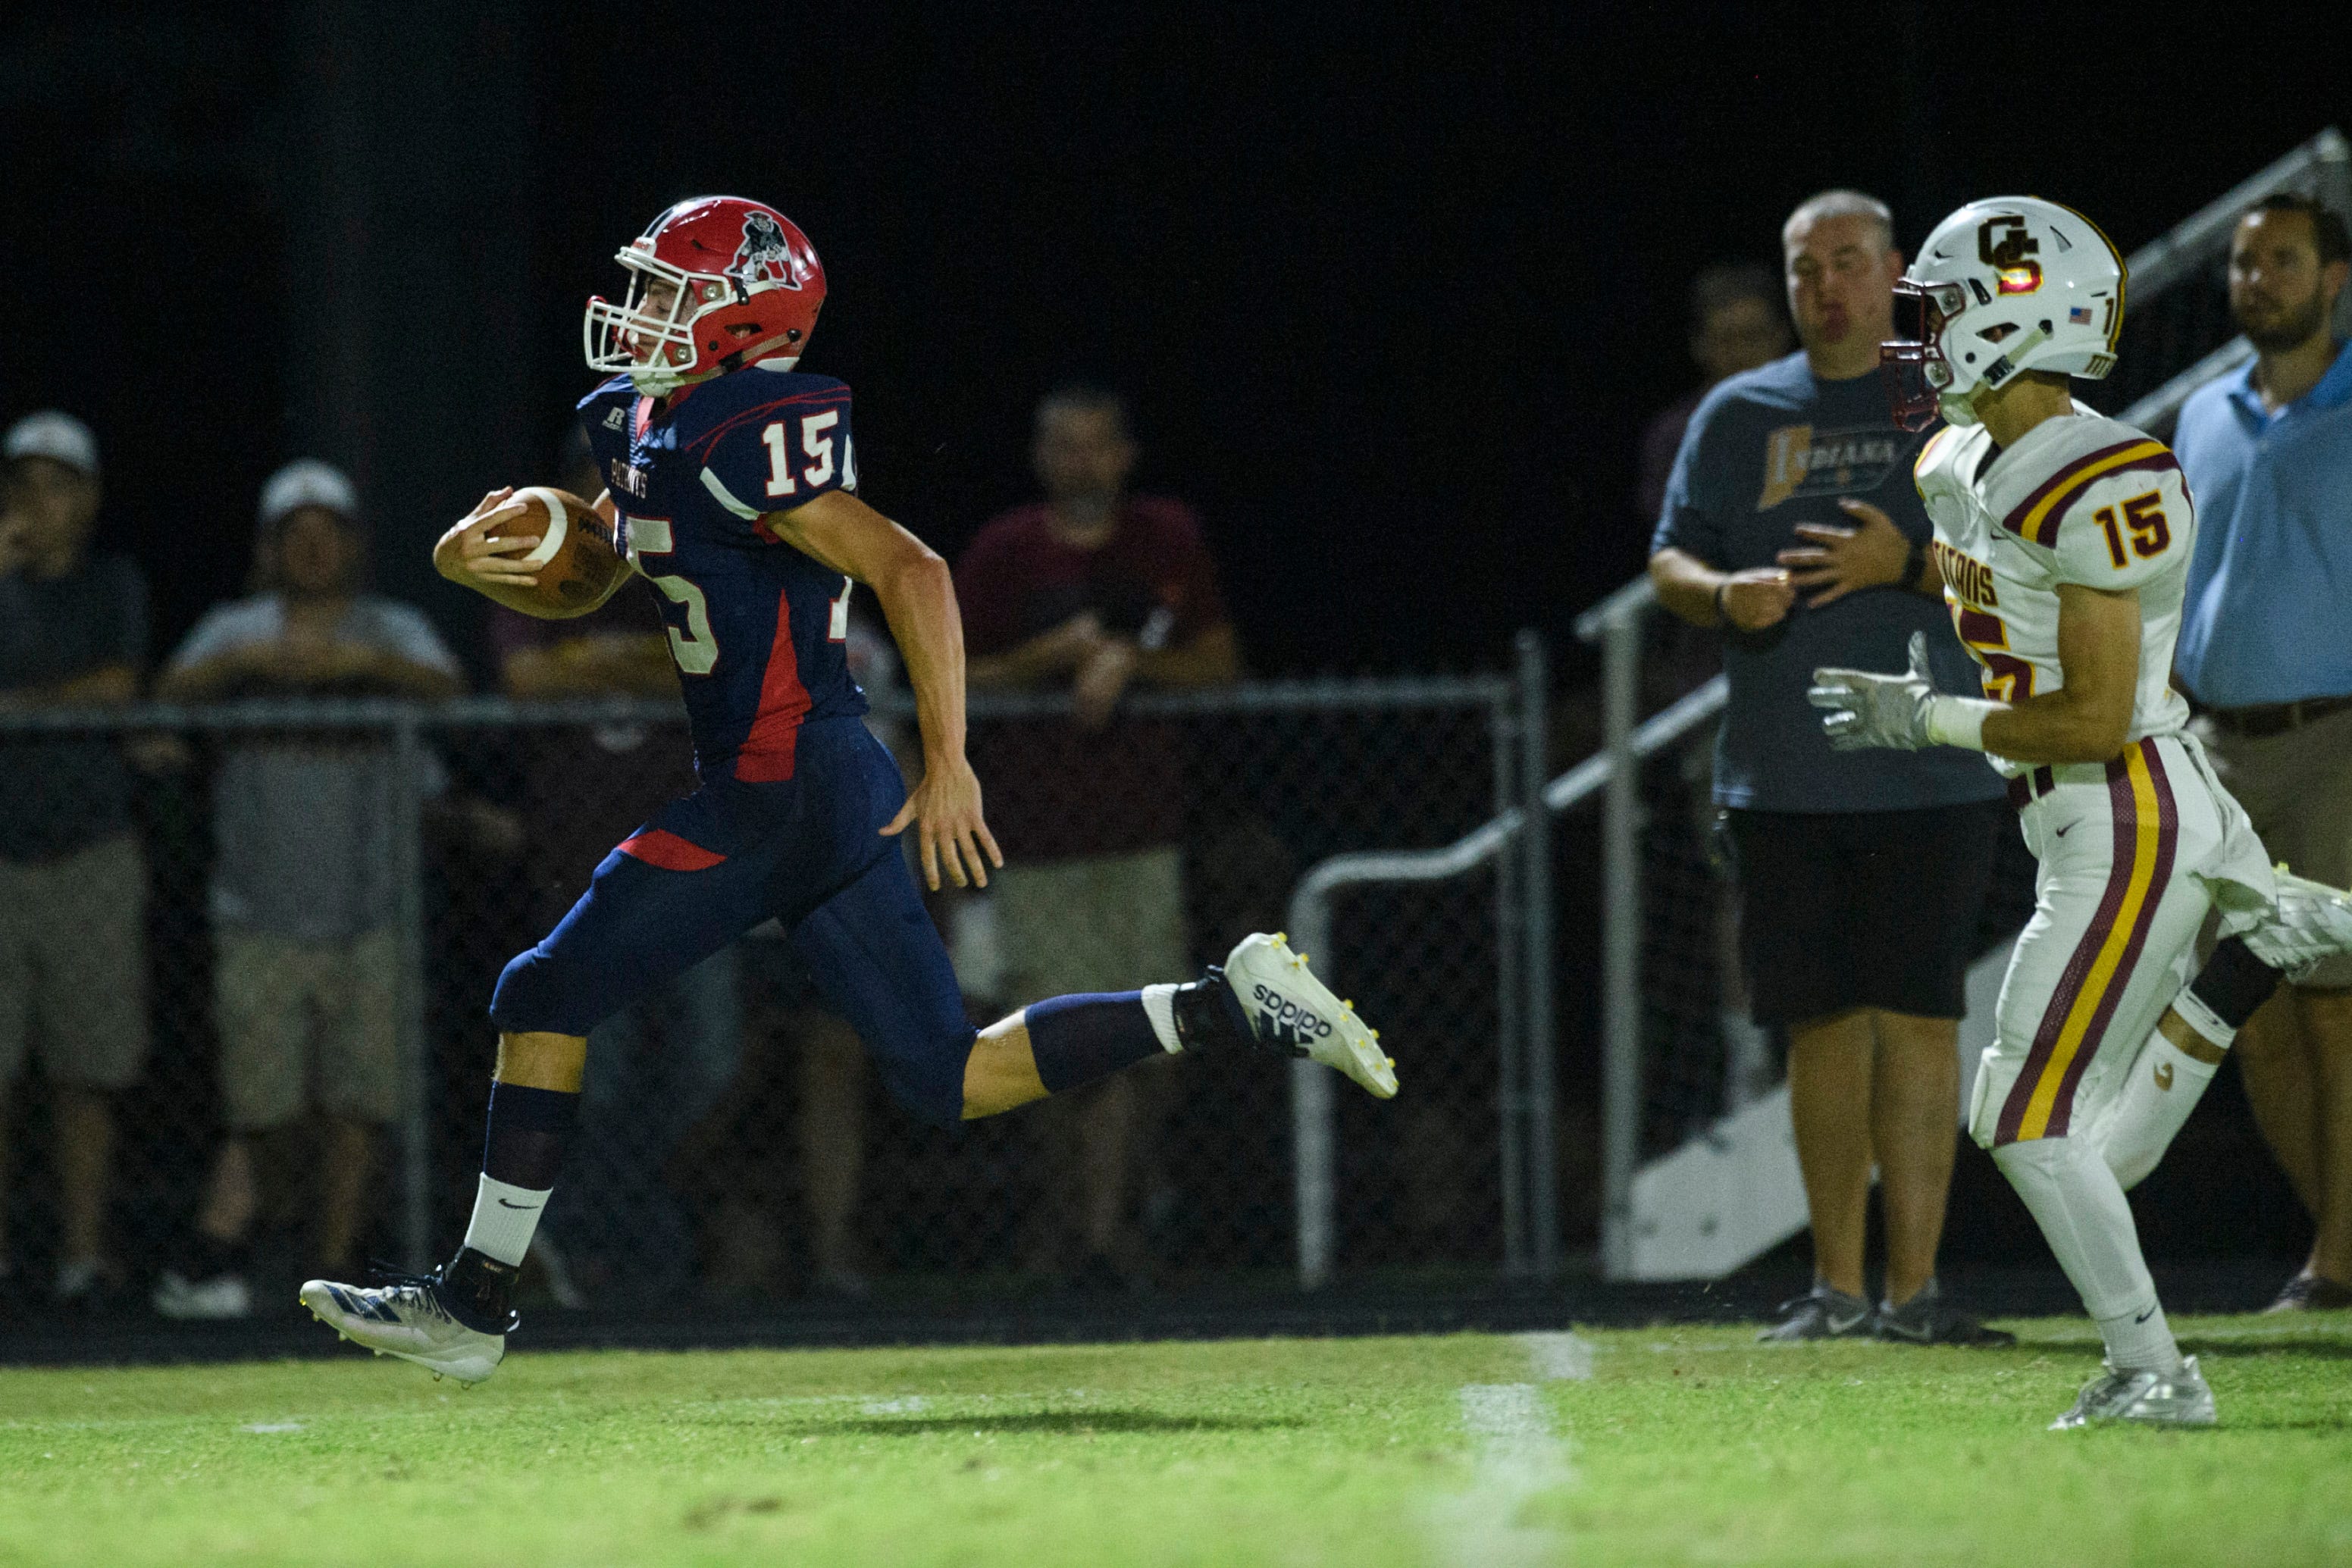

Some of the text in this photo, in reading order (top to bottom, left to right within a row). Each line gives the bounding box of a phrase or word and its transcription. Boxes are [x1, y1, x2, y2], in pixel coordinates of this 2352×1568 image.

[762, 408, 838, 497] 15
[2094, 489, 2171, 570] 15
[615, 508, 719, 676] 5
[1946, 597, 2037, 703] 5
[1253, 984, 1333, 1038] adidas
